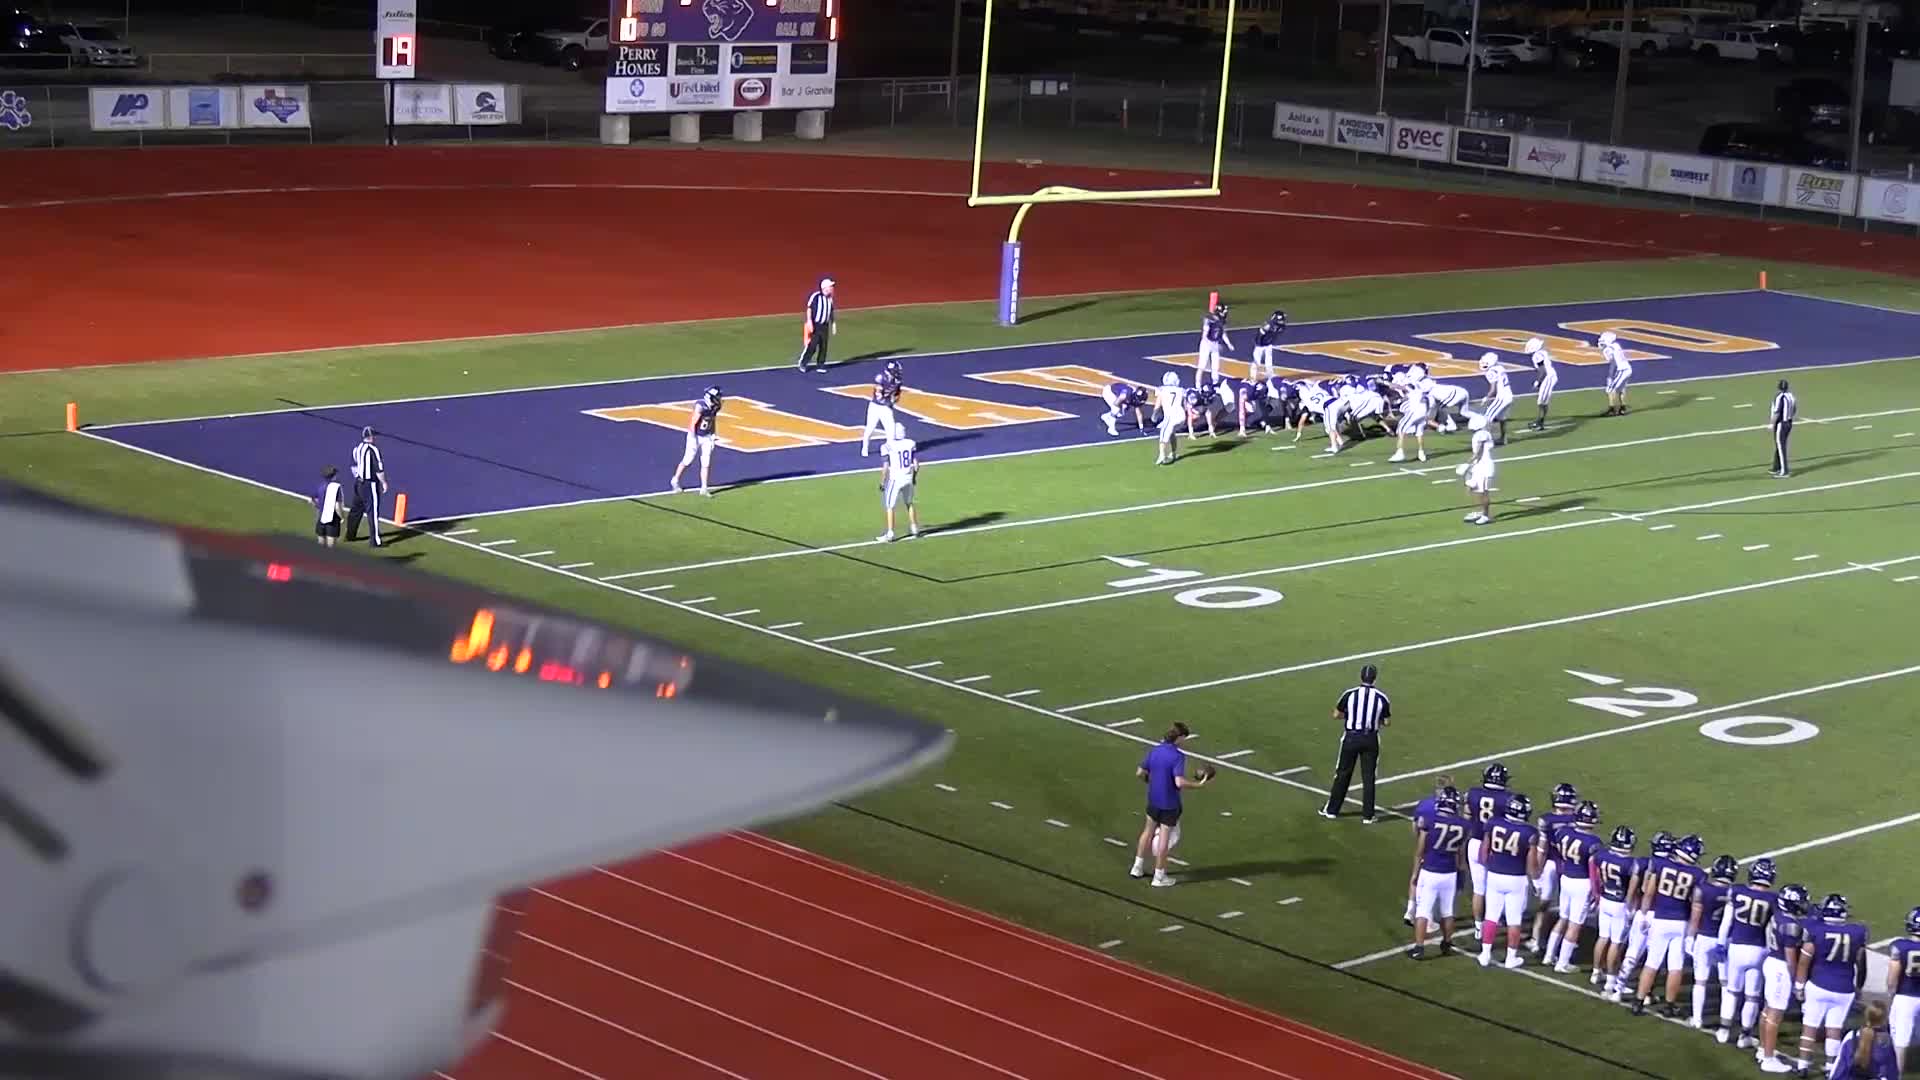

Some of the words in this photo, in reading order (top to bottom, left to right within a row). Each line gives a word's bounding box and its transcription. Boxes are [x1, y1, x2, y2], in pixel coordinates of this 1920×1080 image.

[776, 22, 798, 36] BALL
[392, 36, 412, 66] 19
[619, 46, 658, 60] PERRY
[615, 61, 661, 75] HOMES
[782, 87, 794, 96] Bar
[805, 86, 833, 96] Granite
[1280, 124, 1324, 138] SeasonAll
[1287, 112, 1320, 125] Anita's
[1397, 127, 1444, 149] gvec
[898, 450, 910, 468] 18
[1479, 796, 1495, 823] 8
[1433, 823, 1463, 852] 72
[1491, 826, 1521, 857] 64
[1561, 835, 1582, 865] 14
[1600, 860, 1621, 887] 15
[1658, 867, 1693, 901] 68
[1735, 893, 1769, 927] 20
[1824, 933, 1851, 962] 71
